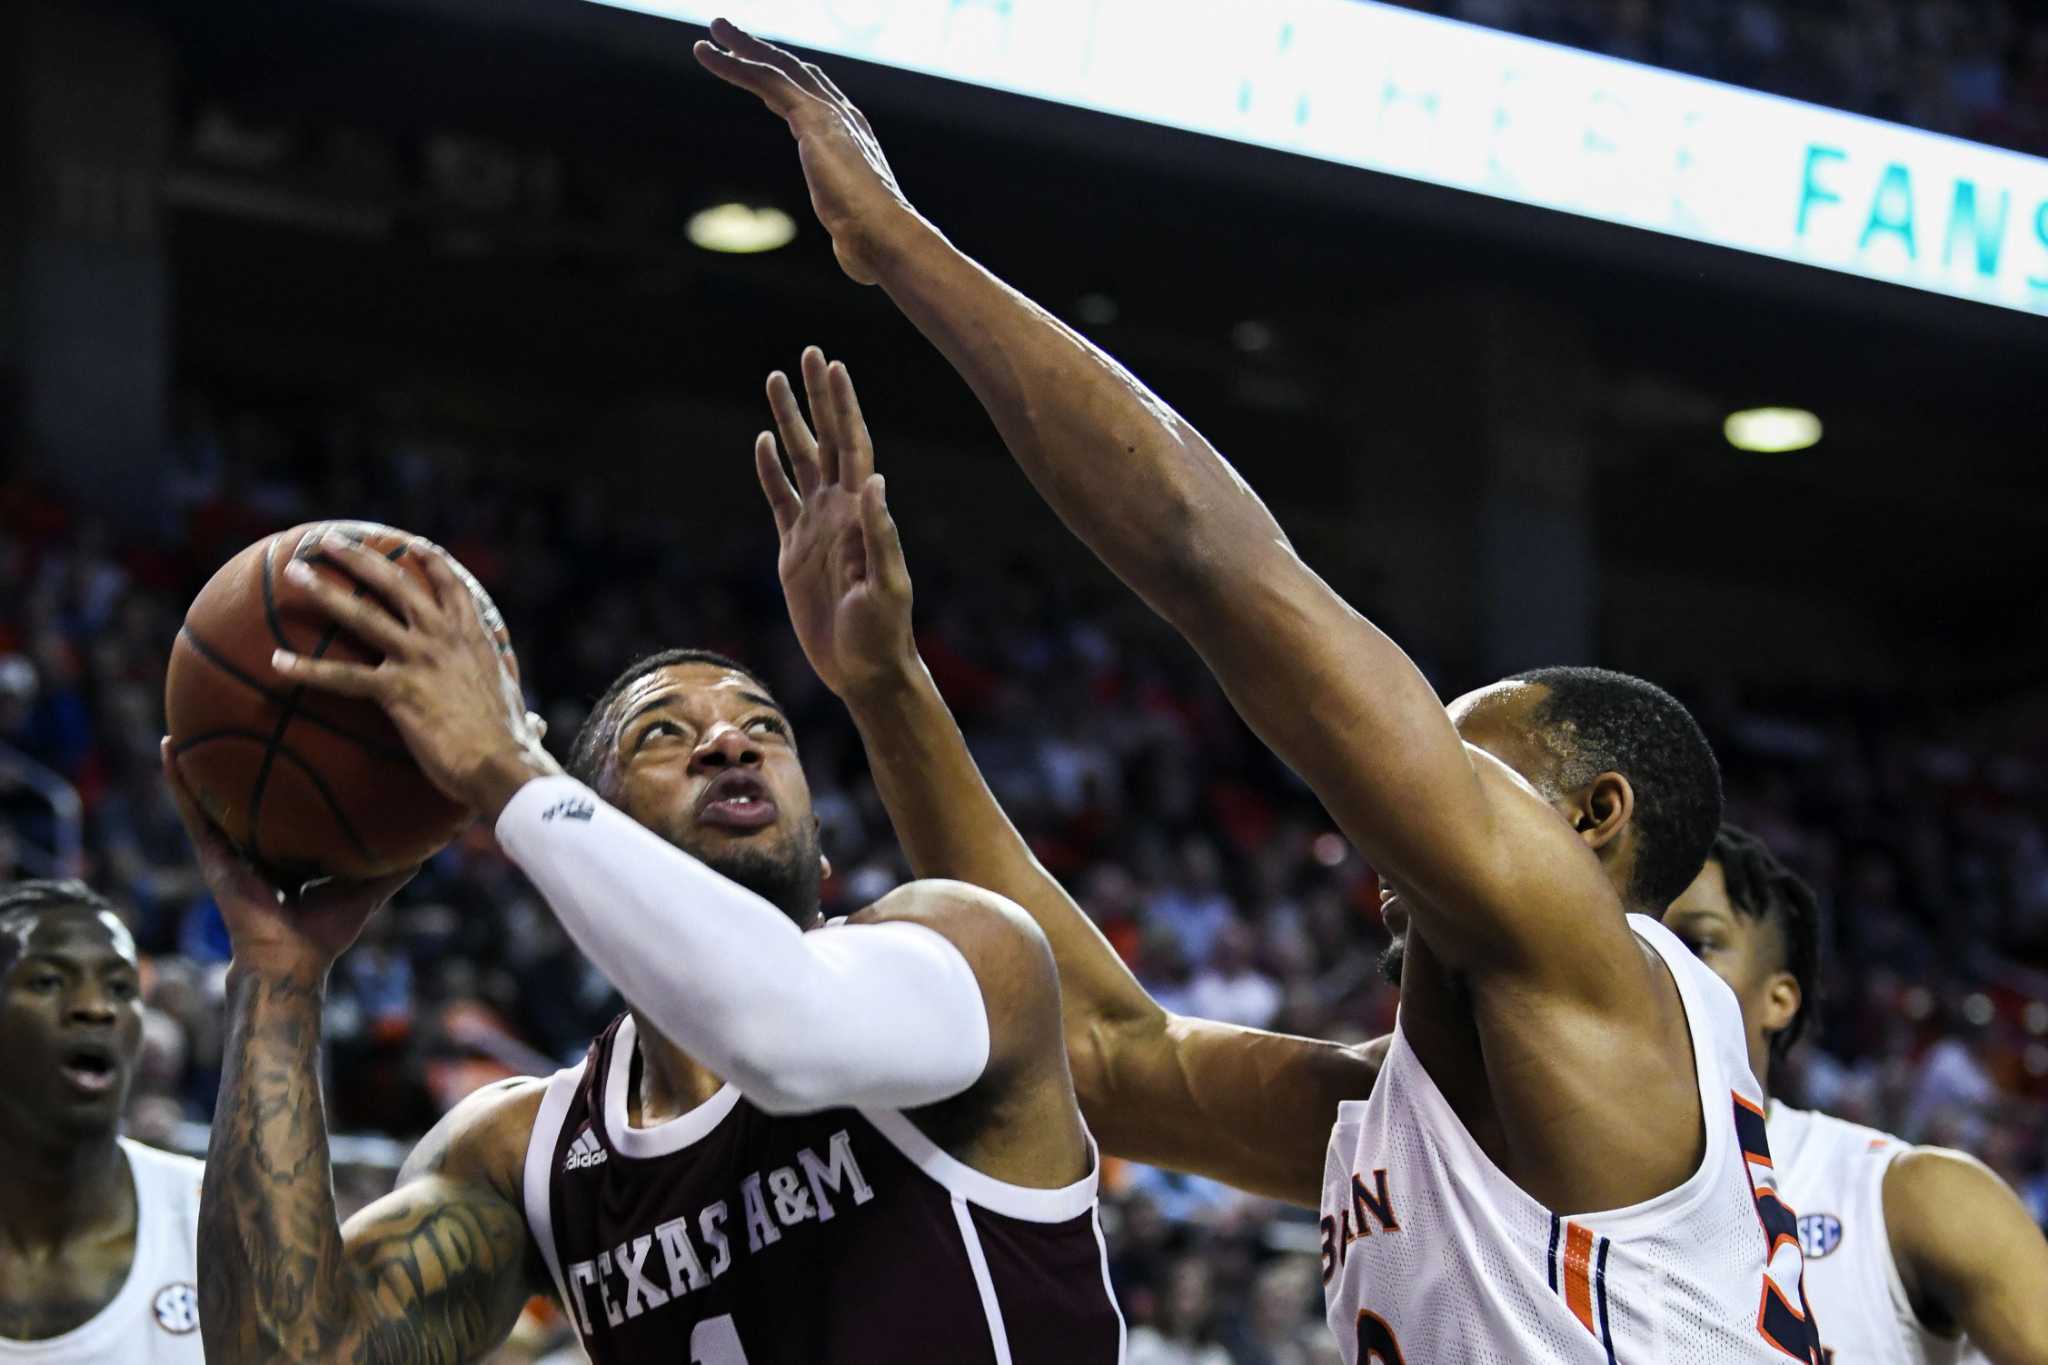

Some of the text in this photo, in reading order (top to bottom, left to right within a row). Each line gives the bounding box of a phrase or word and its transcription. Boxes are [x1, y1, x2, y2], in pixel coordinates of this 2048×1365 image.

[564, 1149, 608, 1171] didas
[568, 1129, 875, 1335] TEXAS A&M
